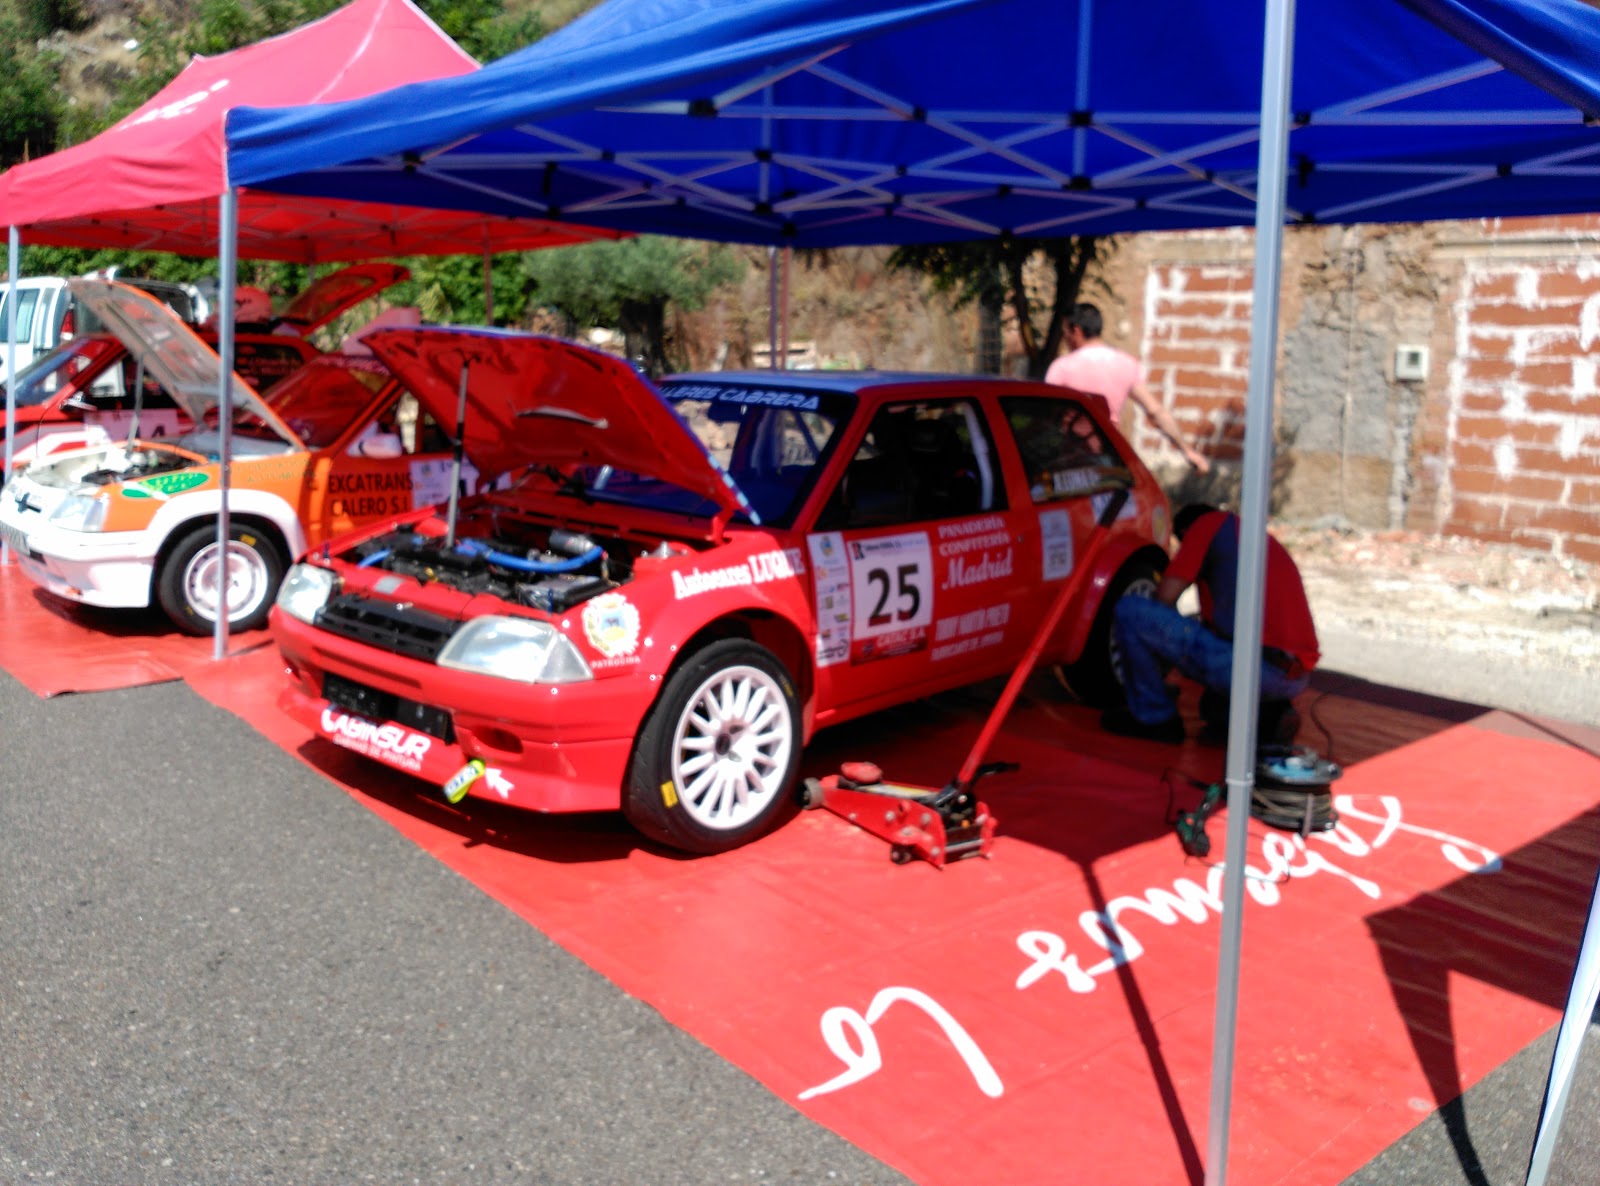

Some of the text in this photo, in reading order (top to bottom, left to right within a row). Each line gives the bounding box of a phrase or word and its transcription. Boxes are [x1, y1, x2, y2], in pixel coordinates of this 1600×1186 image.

[656, 386, 819, 410] LLERES CABRERA
[328, 471, 413, 494] EXCATRANS
[331, 496, 387, 517] CALERO
[672, 548, 806, 600] Autocares LUQUE
[941, 547, 1013, 591] Madrid
[867, 563, 920, 628] 25
[591, 656, 642, 668] PATROCINA
